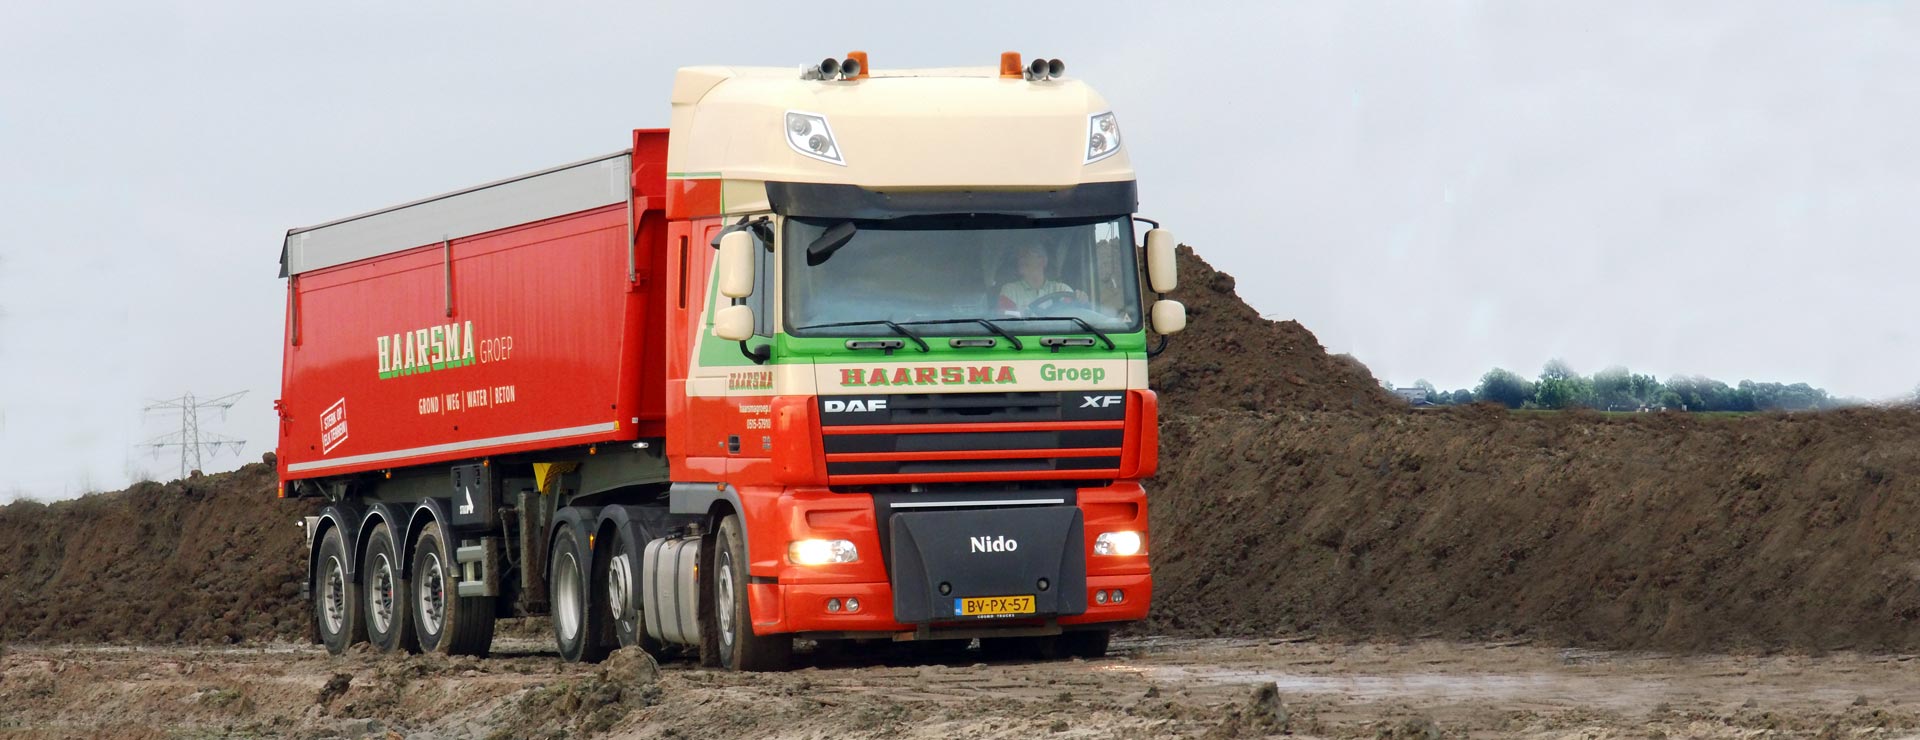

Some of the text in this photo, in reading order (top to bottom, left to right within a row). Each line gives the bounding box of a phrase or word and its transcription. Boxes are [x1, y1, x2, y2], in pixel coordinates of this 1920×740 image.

[377, 320, 513, 380] HAARSMA GROEP
[729, 371, 774, 390] HAARSMA
[839, 363, 1106, 387] HAARSMA Groep
[418, 385, 516, 415] GROND WEG WATER BETON
[824, 400, 887, 413] DAF
[1079, 395, 1122, 408] XF
[970, 535, 1018, 553] Nido
[967, 598, 1030, 613] BV-PX-57
